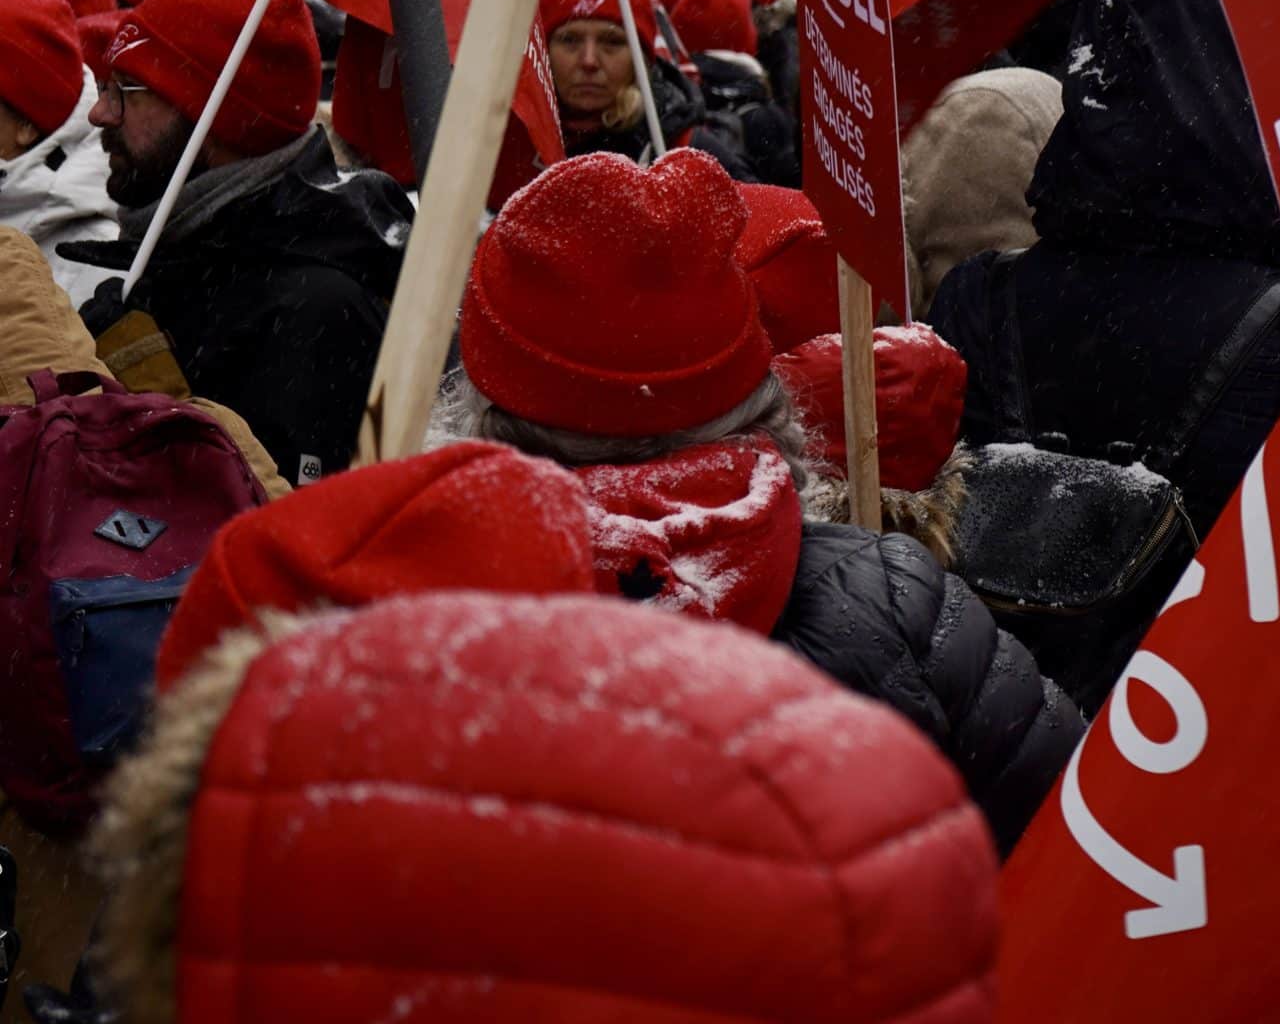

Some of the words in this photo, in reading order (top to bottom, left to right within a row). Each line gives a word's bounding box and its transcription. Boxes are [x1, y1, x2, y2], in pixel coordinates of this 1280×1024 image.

[804, 4, 874, 120] DÉTERMINÉS
[812, 67, 866, 161] ENGAGÉS
[812, 118, 876, 217] MOBILISÉS
